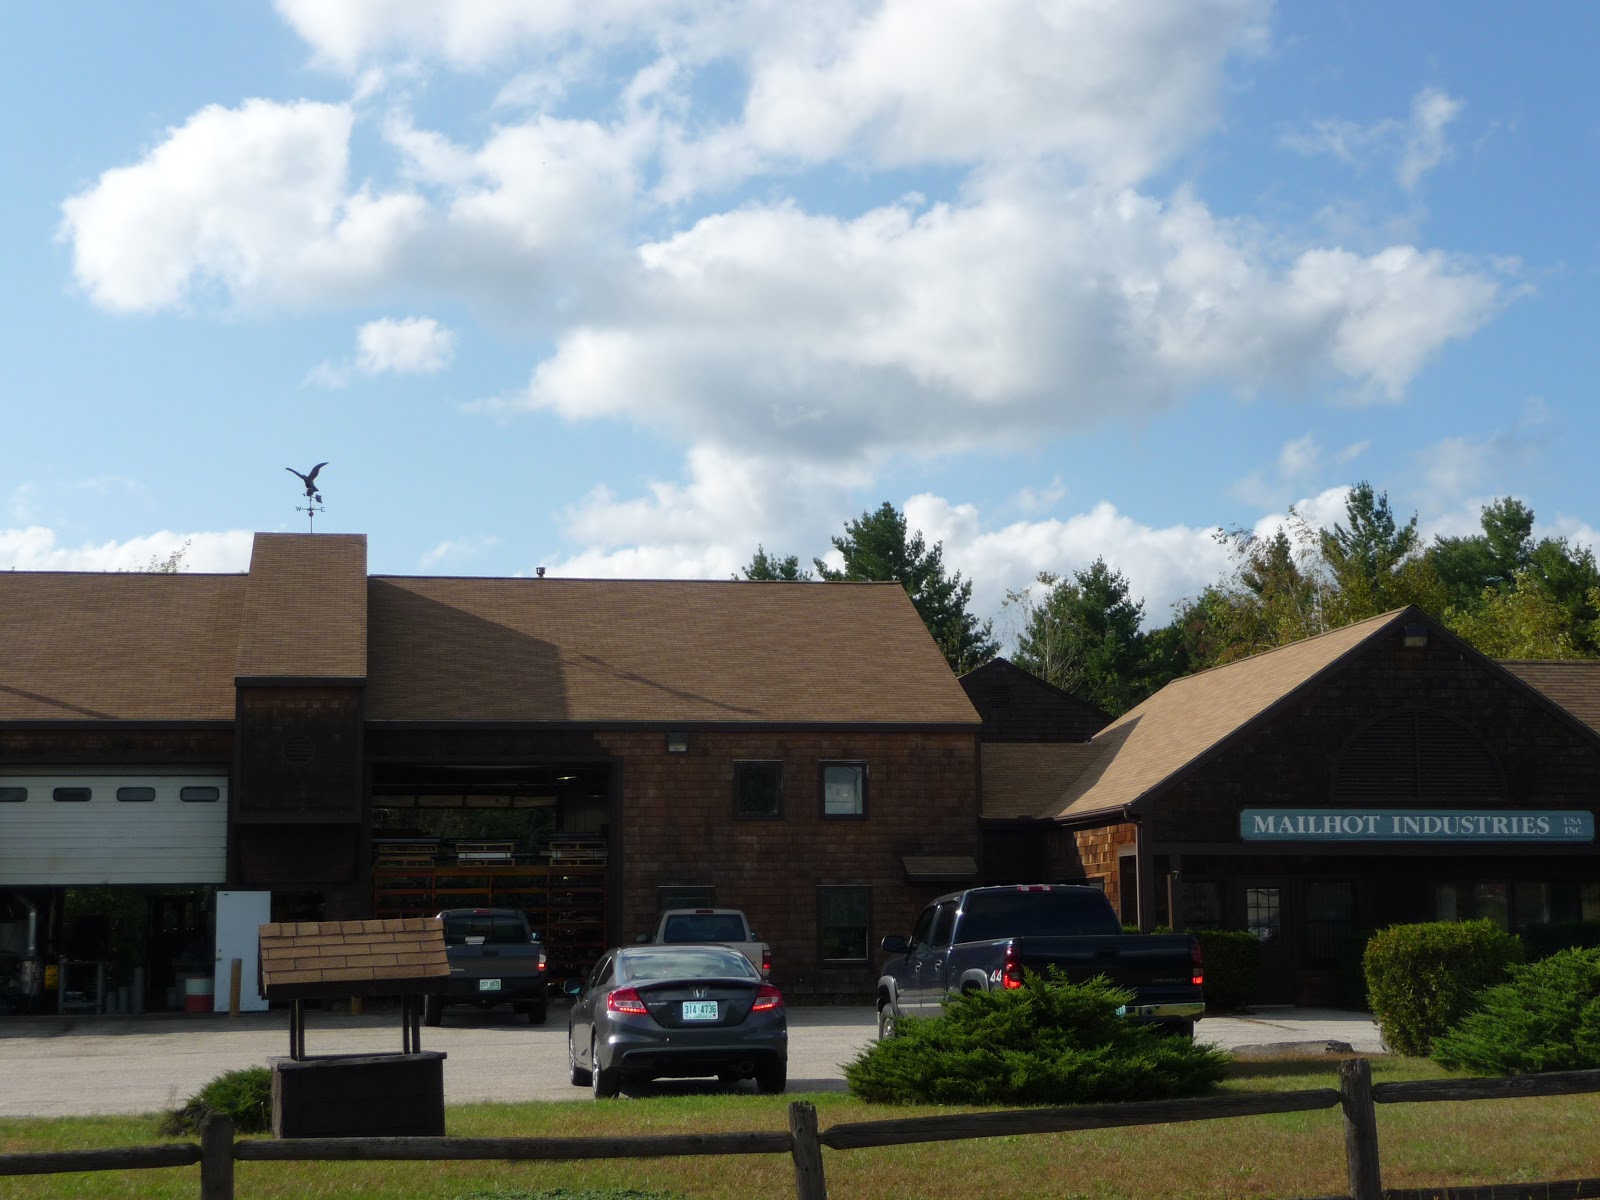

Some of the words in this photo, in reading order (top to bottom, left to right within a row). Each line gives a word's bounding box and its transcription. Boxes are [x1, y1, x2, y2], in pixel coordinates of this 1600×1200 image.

[1253, 815, 1380, 834] MAILHOT
[1391, 816, 1550, 835] INDUSTRIES
[1563, 816, 1582, 825] USA
